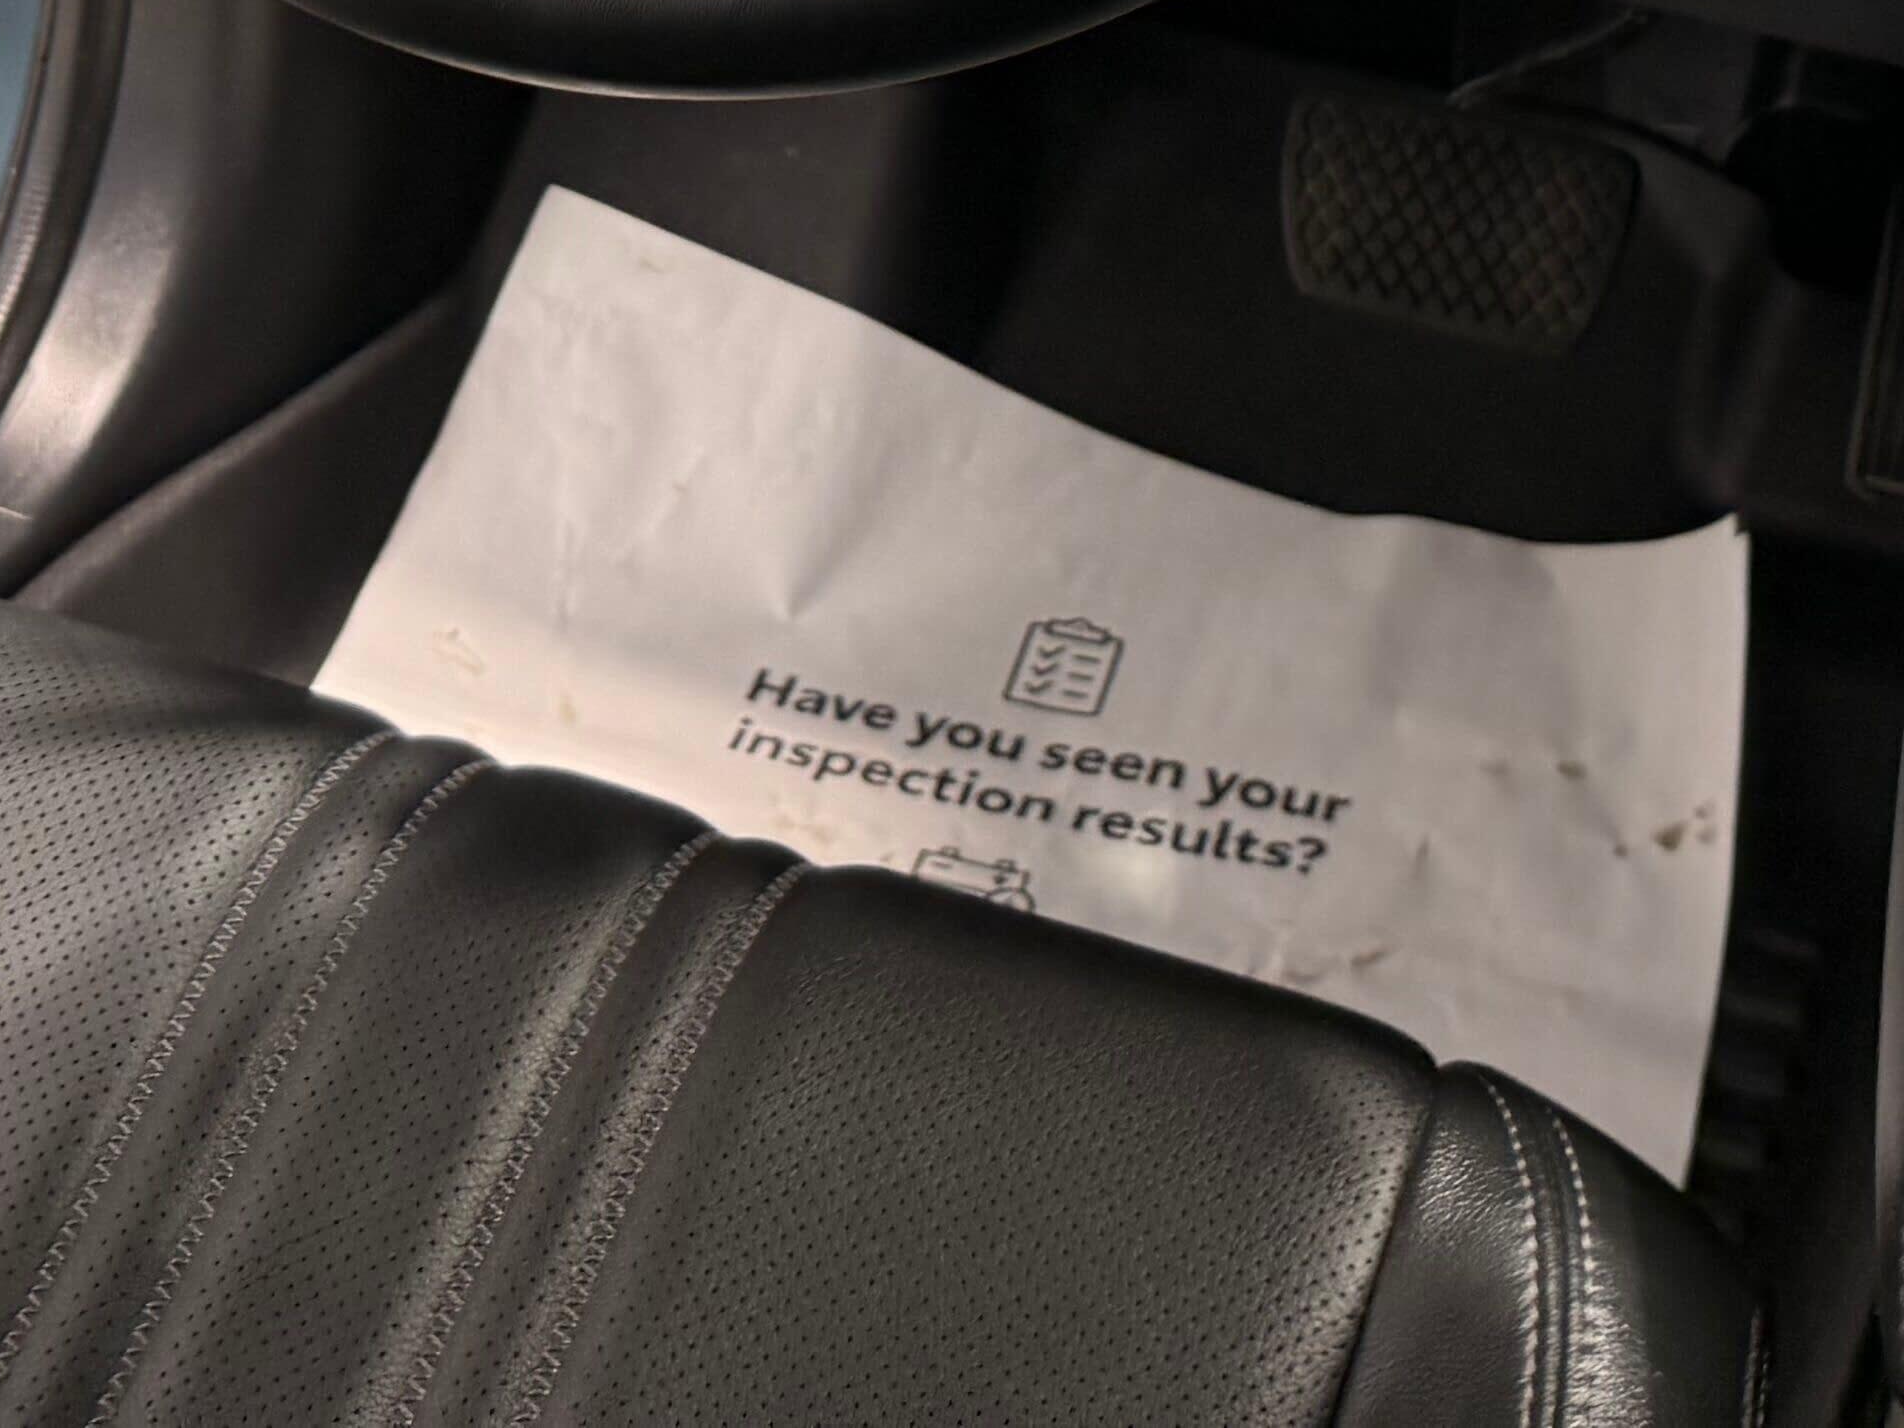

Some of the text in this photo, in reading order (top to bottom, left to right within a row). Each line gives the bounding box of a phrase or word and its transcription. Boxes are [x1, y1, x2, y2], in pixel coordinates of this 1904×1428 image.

[728, 717, 1330, 876] inspection results?
[745, 666, 1352, 825] Have you seen your
